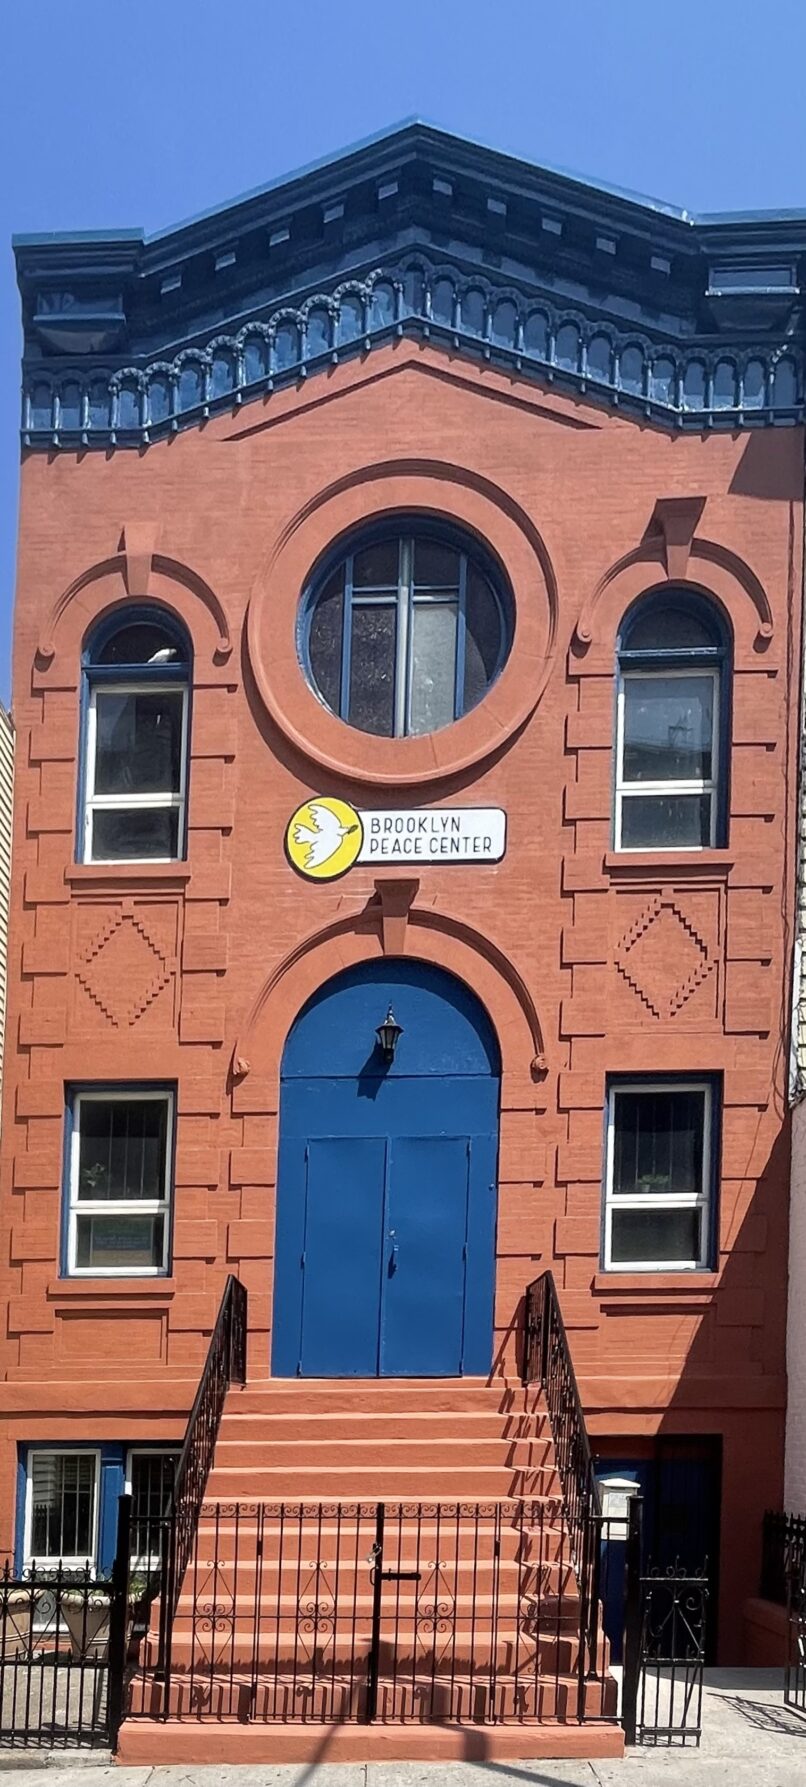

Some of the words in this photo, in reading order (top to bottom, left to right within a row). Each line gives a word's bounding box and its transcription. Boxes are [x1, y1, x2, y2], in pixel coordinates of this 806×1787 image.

[371, 816, 461, 834] BROOKLYN
[370, 837, 423, 855] PEACE
[429, 836, 492, 854] CENTER
